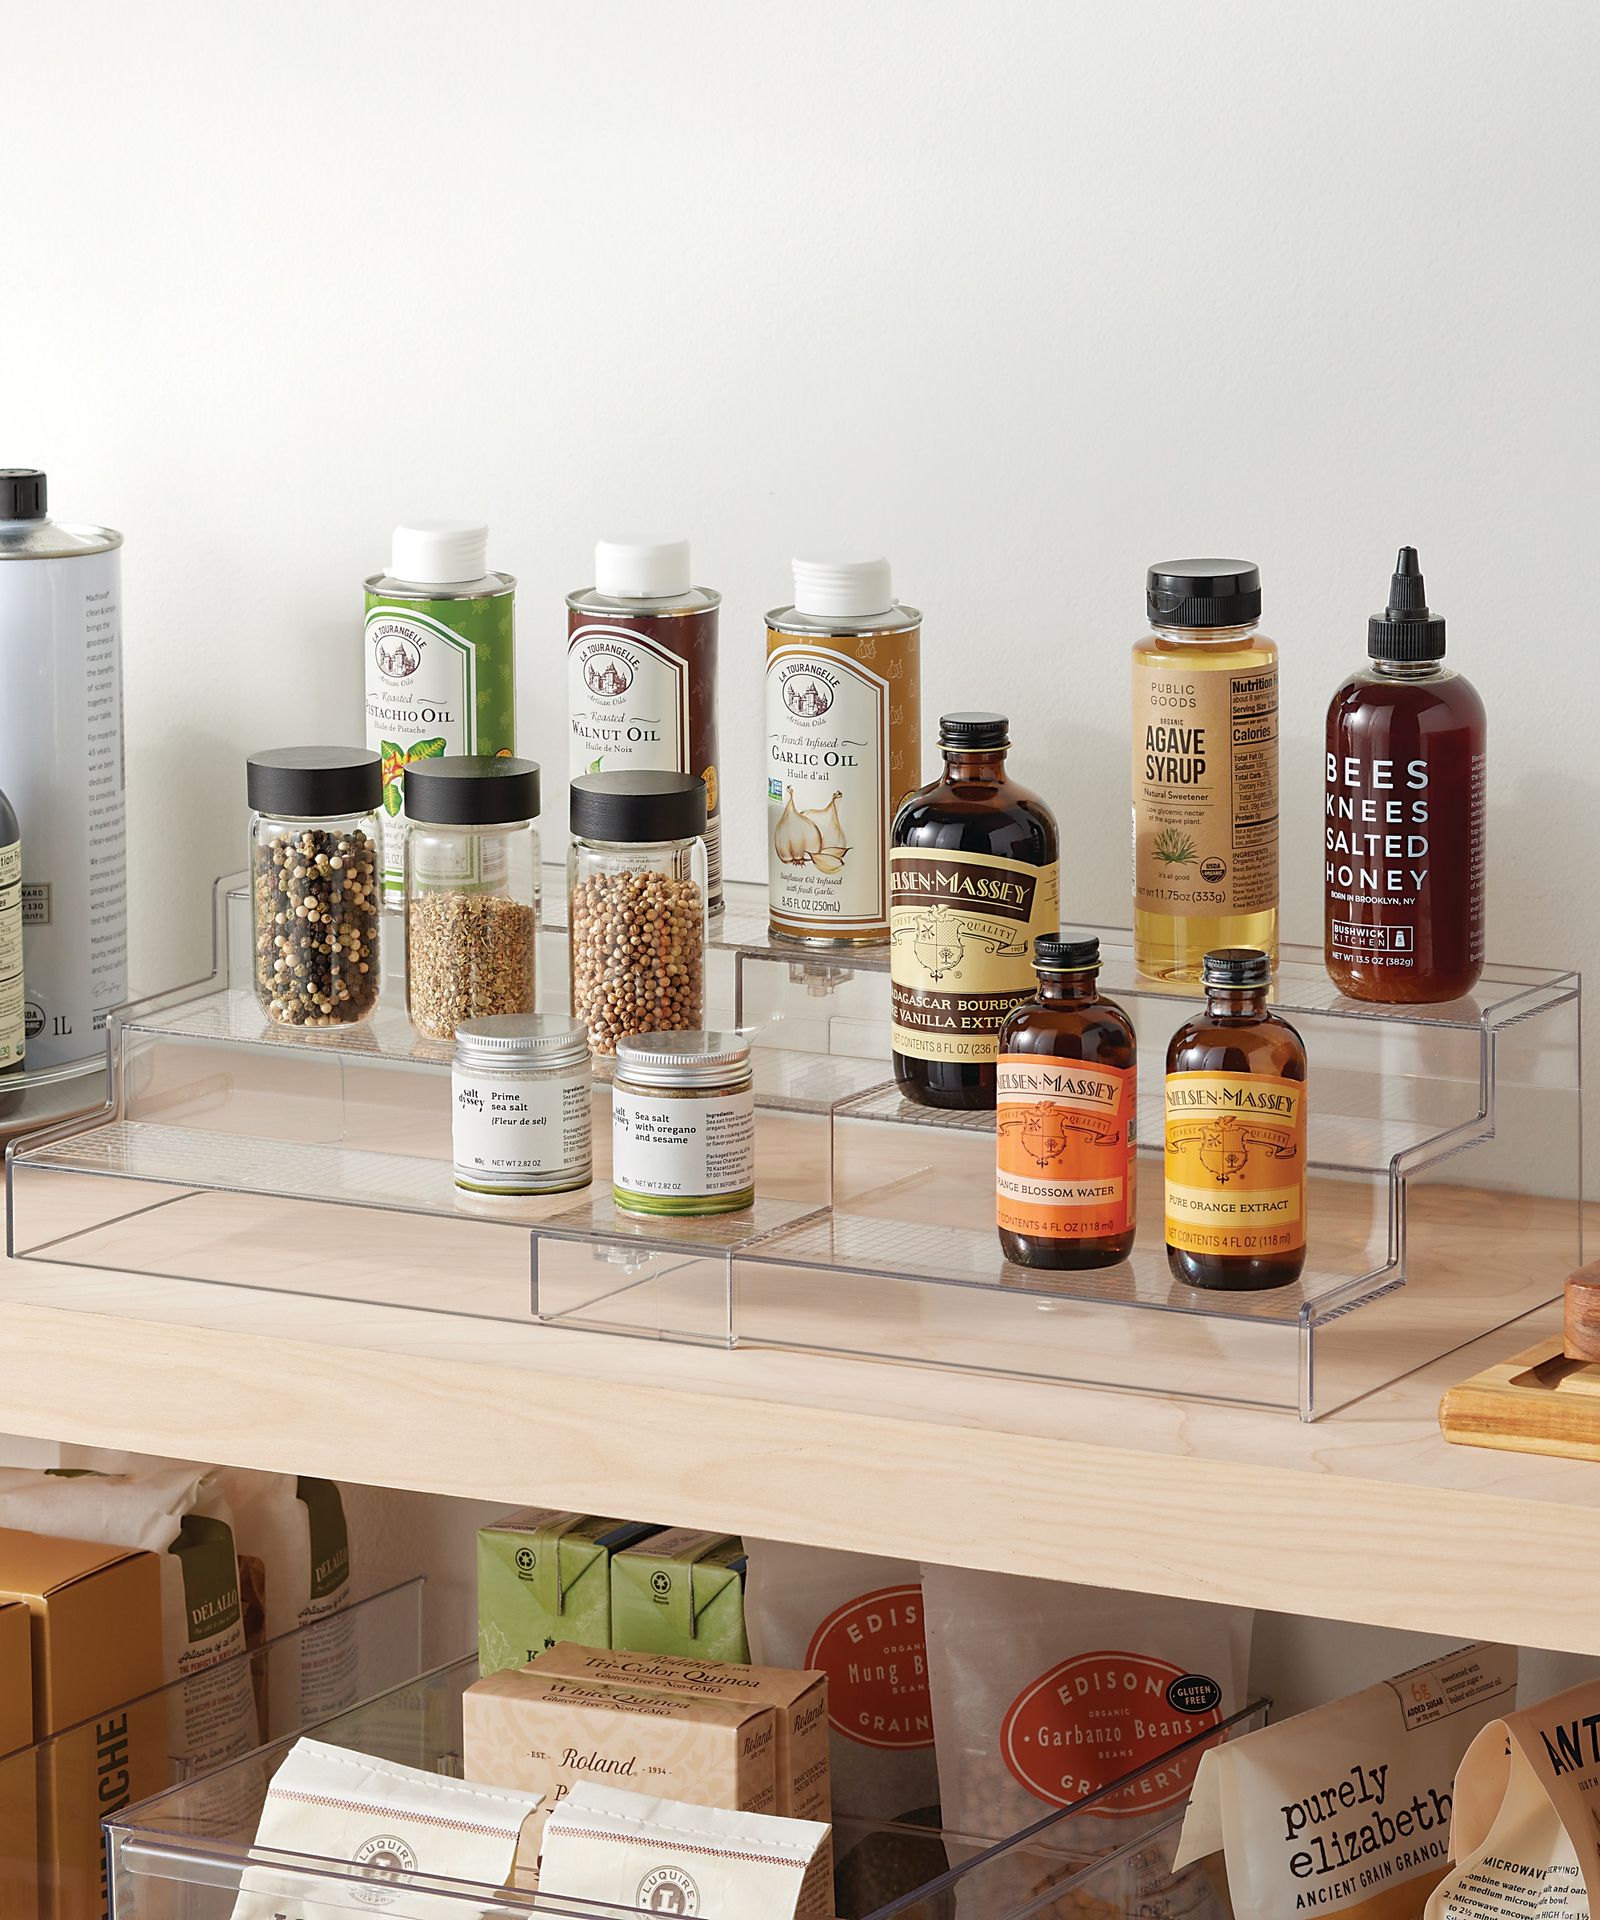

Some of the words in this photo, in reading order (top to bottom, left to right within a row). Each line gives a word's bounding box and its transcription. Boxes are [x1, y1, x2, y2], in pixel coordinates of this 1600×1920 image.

[379, 623, 427, 649] TOURANGELLE
[587, 643, 640, 668] TOURANGELLE
[786, 663, 841, 688] TOURANGELLE
[1151, 682, 1195, 695] PUBLIC
[1232, 678, 1272, 693] Nutrition
[381, 692, 413, 704] Roasted
[1150, 696, 1197, 708] GOODS
[421, 708, 454, 723] OIL
[590, 711, 625, 723] Roasted
[1160, 718, 1184, 726] ORGANIC
[397, 725, 426, 735] Pistache
[572, 719, 621, 742] WALNUT
[627, 726, 661, 742] OIL
[1233, 726, 1271, 741] Calories
[585, 742, 602, 752] Huile
[604, 744, 612, 752] de
[614, 745, 632, 753] Noix
[805, 736, 838, 748] Infused
[1146, 725, 1205, 755] AGAVE
[772, 745, 818, 767] GARLIC
[823, 751, 858, 767] OIL
[787, 768, 808, 780] Huile
[1146, 754, 1206, 784] SYRUP
[1326, 752, 1429, 790] BEES
[1144, 788, 1166, 799] Natural
[1168, 790, 1209, 800] Sweetener
[1326, 792, 1429, 823] KNEES
[1235, 814, 1254, 822] Protein
[1326, 827, 1429, 858] SALTED
[805, 875, 815, 884] Oil
[816, 876, 842, 886] Infused
[1326, 861, 1429, 891] HONEY
[813, 887, 835, 896] Garlic
[1191, 891, 1226, 904] (333g)
[1331, 891, 1346, 900] BORN
[1355, 895, 1401, 905] BROOKLYN,
[794, 898, 801, 909] FL
[802, 899, 811, 910] OZ
[966, 921, 1013, 940] QUALITY
[1334, 924, 1384, 938] BUSHWICK
[1334, 933, 1385, 947] KITCHEN
[1332, 951, 1342, 959] NET
[1356, 955, 1370, 964] 13.5
[1386, 957, 1414, 967] (382g)
[52, 1015, 73, 1036] 1L
[900, 1011, 957, 1029] VANILLA
[961, 1015, 1003, 1029] EXTR
[901, 1034, 935, 1052] CONTENTS
[936, 1041, 942, 1053] 8
[944, 1042, 954, 1053] FL
[957, 1044, 970, 1054] OZ
[492, 1092, 520, 1101] Prime
[510, 1103, 528, 1111] salt
[492, 1117, 517, 1126] (Fleur
[532, 1117, 547, 1126] sel)
[635, 1112, 649, 1121] Sea
[652, 1114, 669, 1122] salt
[1069, 1115, 1108, 1130] QUALITY
[635, 1123, 654, 1132] with
[657, 1126, 696, 1135] oregano
[1250, 1130, 1287, 1144] QUALITY
[1021, 1185, 1073, 1198] BLOSSOM
[1076, 1186, 1114, 1198] WATER
[1169, 1194, 1188, 1207] PURE
[1190, 1200, 1236, 1213] ORANGE
[1240, 1200, 1289, 1213] EXTRACT
[1001, 1213, 1040, 1230] CONTENTS
[1050, 1222, 1061, 1232] FL
[1064, 1222, 1078, 1232] OZ
[1178, 1230, 1220, 1247] CONTENTS
[1222, 1237, 1228, 1246] 4
[1231, 1238, 1242, 1248] FL
[1244, 1237, 1257, 1247] OZ
[1259, 1235, 1278, 1248] (118
[584, 1657, 680, 1678] Tri-Color
[683, 1670, 760, 1690] Quinoa
[849, 1663, 898, 1684] Mung
[1441, 1667, 1469, 1684] sweetened
[1468, 1663, 1480, 1674] with
[596, 1671, 655, 1685] Gluten-Free
[664, 1680, 721, 1694] Non-GMO
[1057, 1671, 1164, 1706] EDISON
[1445, 1681, 1466, 1694] coconut
[550, 1683, 610, 1699] White
[613, 1692, 690, 1710] Quinoa
[1177, 1685, 1212, 1697] GLUTEN
[1411, 1682, 1432, 1703] 6g
[542, 1694, 605, 1709] Gluten-Free
[611, 1703, 671, 1717] Non-GMO
[1185, 1695, 1207, 1706] FREE
[1449, 1693, 1465, 1705] baked
[1089, 1708, 1131, 1718] ORGANIC
[1407, 1704, 1426, 1718] ADDED
[1426, 1697, 1444, 1711] SUGAR
[792, 1702, 824, 1735] Roland
[859, 1712, 929, 1732] GRAIN
[742, 1723, 772, 1757] Roland
[1038, 1724, 1121, 1748] Garbanzo
[1134, 1718, 1192, 1740] Beans
[1098, 1749, 1134, 1759] BEANS
[557, 1747, 636, 1777] Roland
[648, 1766, 667, 1775] 1934
[1281, 1763, 1389, 1842] purely
[1290, 1789, 1454, 1880] elizabeth
[358, 1840, 413, 1870] LUQUIRE
[642, 1870, 695, 1900] LUQUIRE
[1296, 1876, 1358, 1910] ANCIENT
[1360, 1860, 1394, 1888] GRAIN
[1468, 1885, 1503, 1899] medium
[1502, 1882, 1525, 1893] water
[1553, 1885, 1568, 1894] and
[1570, 1887, 1587, 1895] oats
[1448, 1904, 1458, 1912] to
[1453, 1895, 1499, 1913] Microwave
[1549, 1897, 1569, 1905] bowl.
[1541, 1911, 1559, 1920] HIGH
[1561, 1911, 1573, 1920] for
